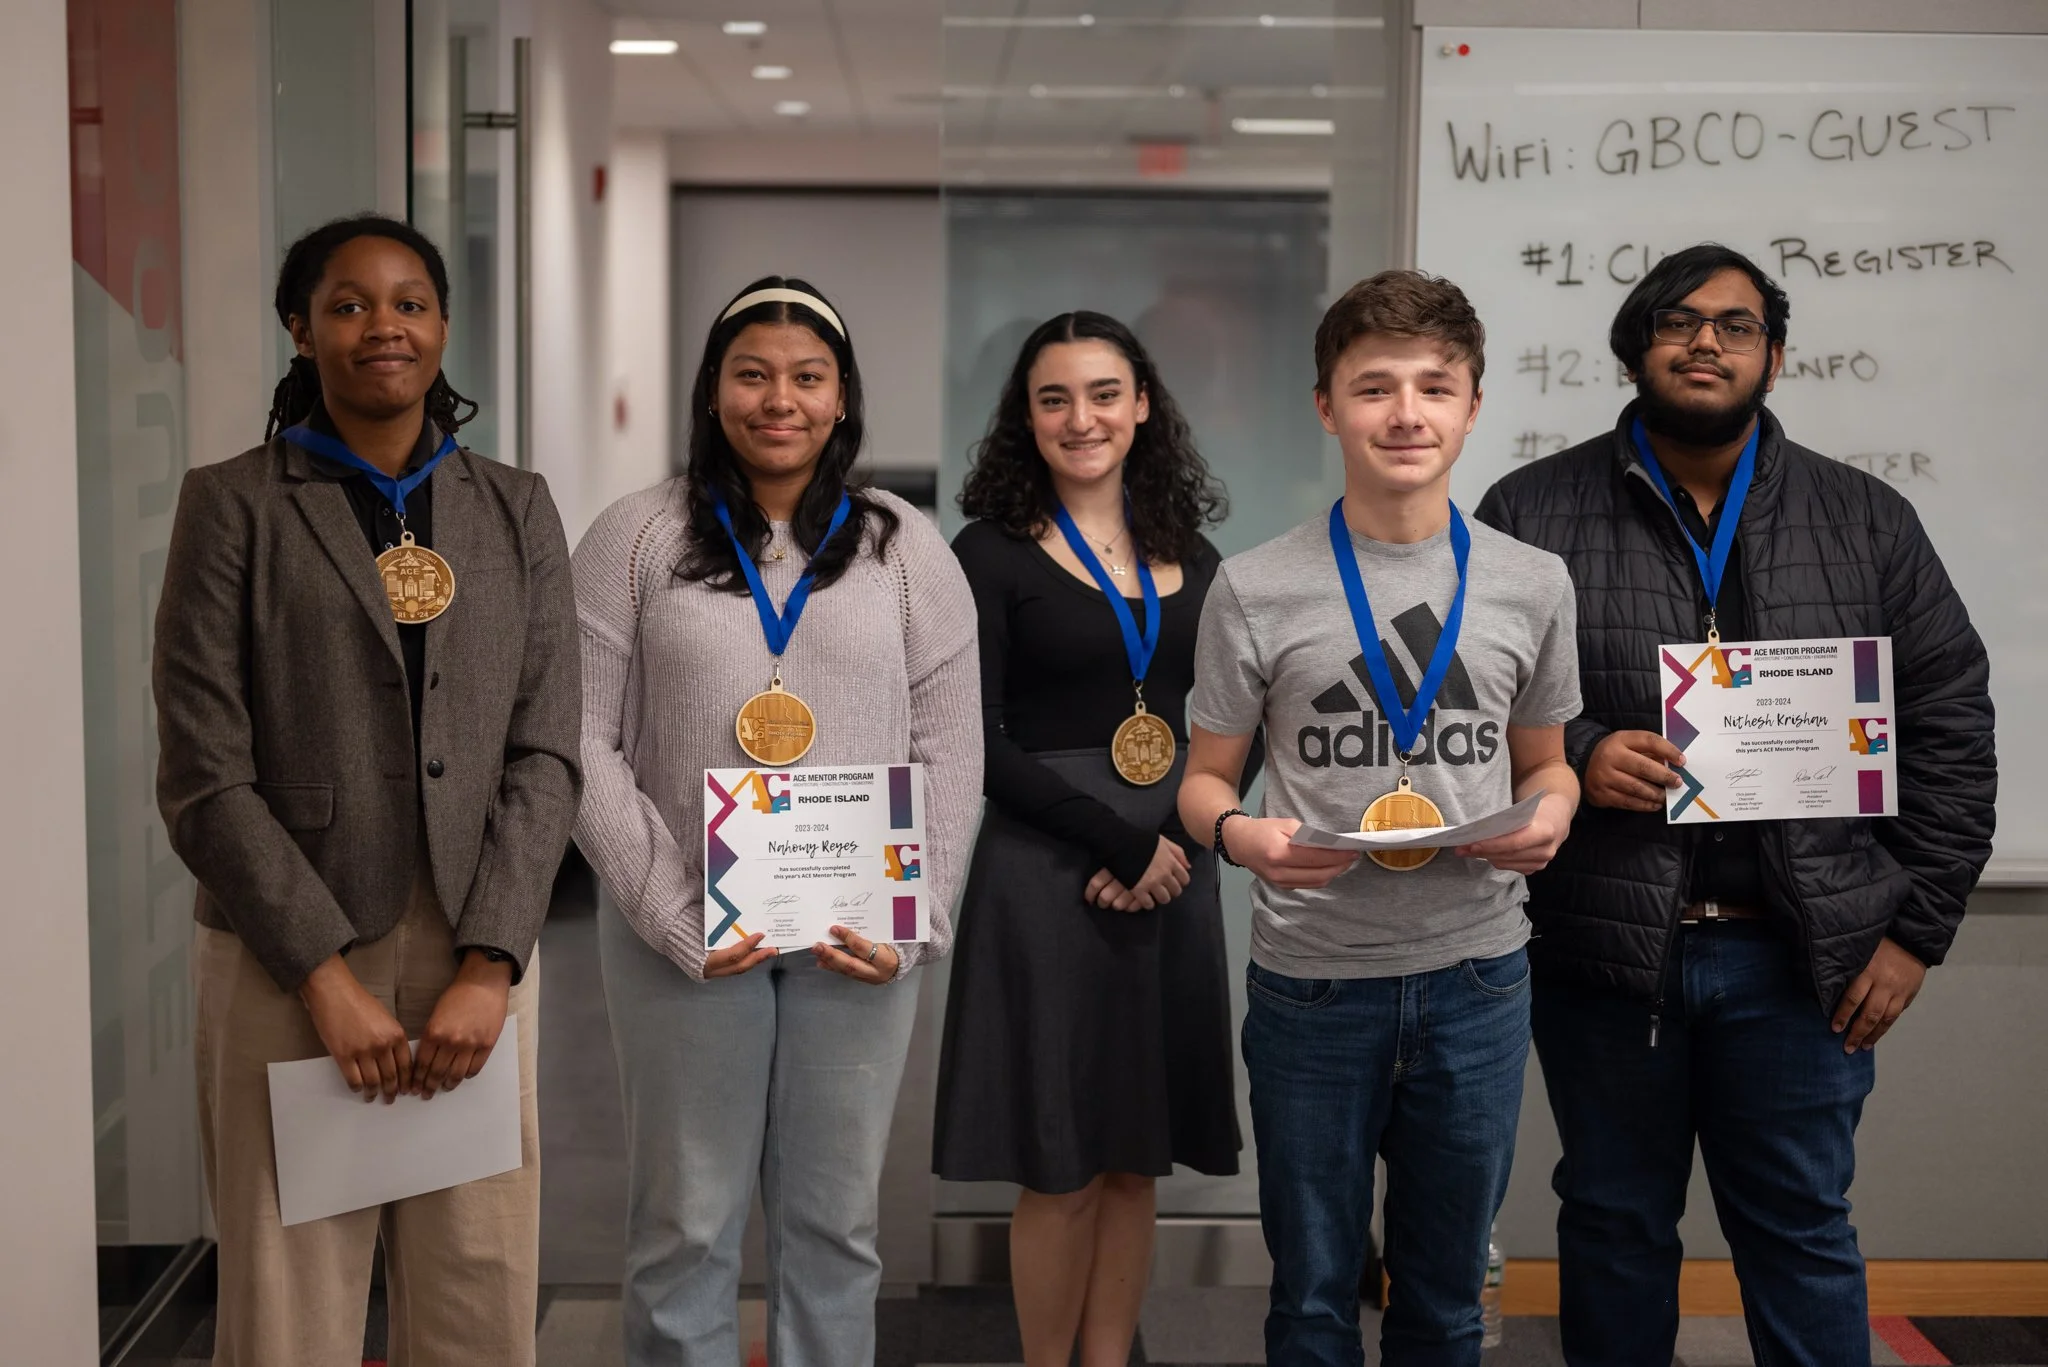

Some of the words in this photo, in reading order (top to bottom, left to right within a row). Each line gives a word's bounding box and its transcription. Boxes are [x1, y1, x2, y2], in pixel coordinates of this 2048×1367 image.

[1769, 237, 2014, 279] REGISTER
[1778, 346, 1880, 383] INFO
[400, 568, 420, 576] ACE
[1753, 648, 1768, 656] ACE
[1769, 647, 1800, 656] MENTOR
[1801, 646, 1838, 655] PROGRAM
[1759, 669, 1794, 678] RHODE
[1796, 668, 1833, 676] ISLAND
[1756, 698, 1791, 706] 2023-2024
[1724, 713, 1775, 730] Nithesh
[1777, 712, 1829, 728] Krishan
[1297, 709, 1499, 768] adidas
[793, 774, 807, 782] ACE
[808, 773, 838, 782] MENTOR
[839, 772, 874, 781] PROGRAM
[798, 795, 832, 804] RHODE
[834, 794, 870, 803] ISLAND
[794, 824, 829, 832] 2023-2024
[822, 840, 860, 858] Reyes
